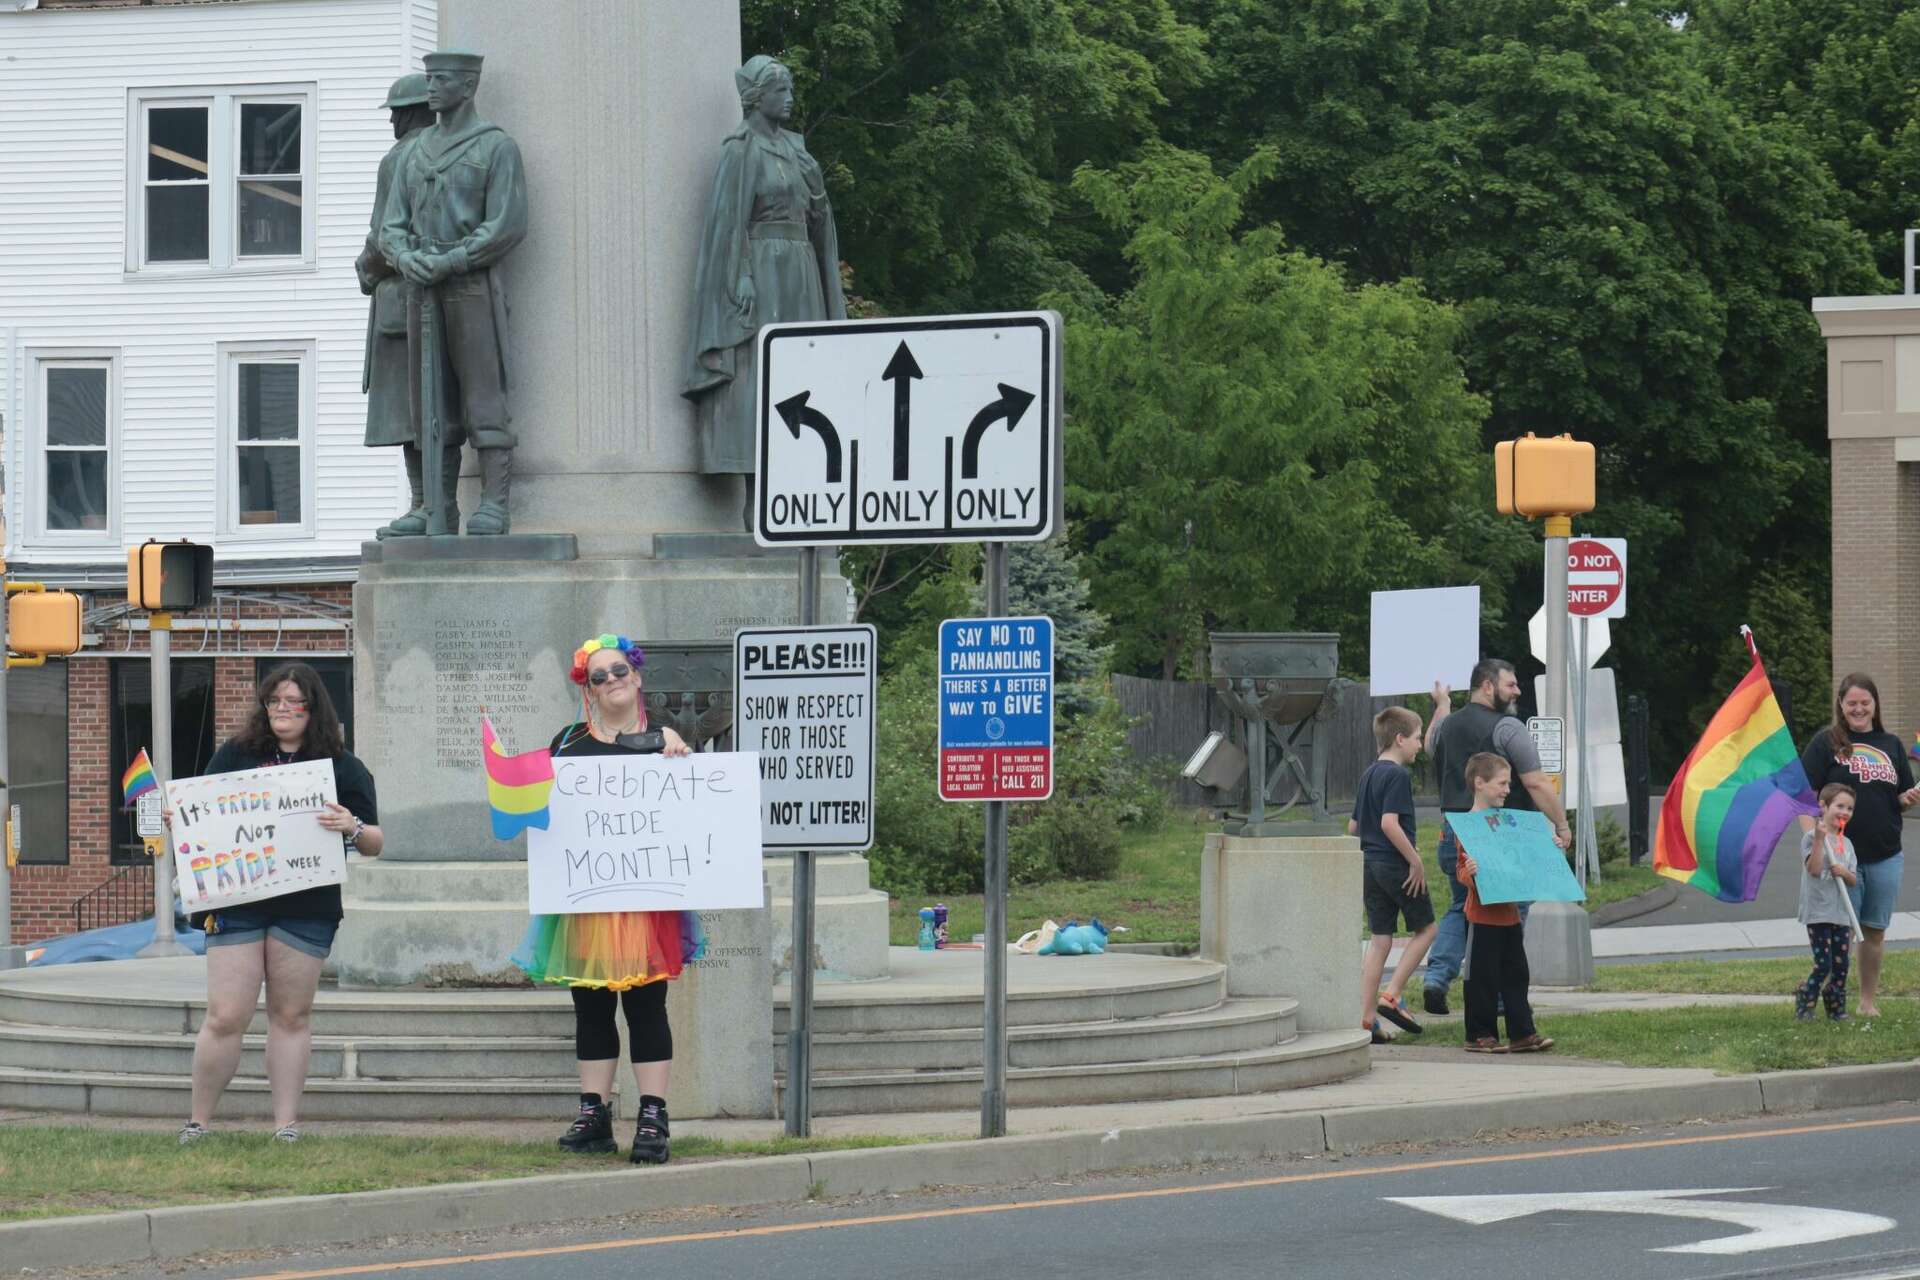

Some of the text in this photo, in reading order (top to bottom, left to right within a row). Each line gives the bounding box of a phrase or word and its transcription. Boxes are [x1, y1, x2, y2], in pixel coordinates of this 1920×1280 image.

[771, 492, 845, 525] ONLY
[862, 489, 939, 523] ONLY
[956, 487, 1035, 520] ONLY
[1568, 555, 1613, 567] O NOT
[957, 625, 1035, 647] SAY NO TO
[744, 642, 866, 671] PLEASE!!!
[951, 650, 1041, 671] PANHANDLING
[944, 678, 1046, 694] THERE'S A BETTER
[745, 694, 864, 720] SHOW RESPECT
[949, 695, 1042, 716] WAY TO GIVE
[762, 725, 847, 750] FOR THOSE
[795, 755, 854, 780] SERVED
[1002, 775, 1044, 790] CALL 211
[585, 809, 663, 838] PRIDE
[770, 802, 803, 825] NOT
[810, 801, 866, 825] LITTER!
[286, 855, 321, 869] WEEK
[715, 947, 763, 957] OFFENSIVE
